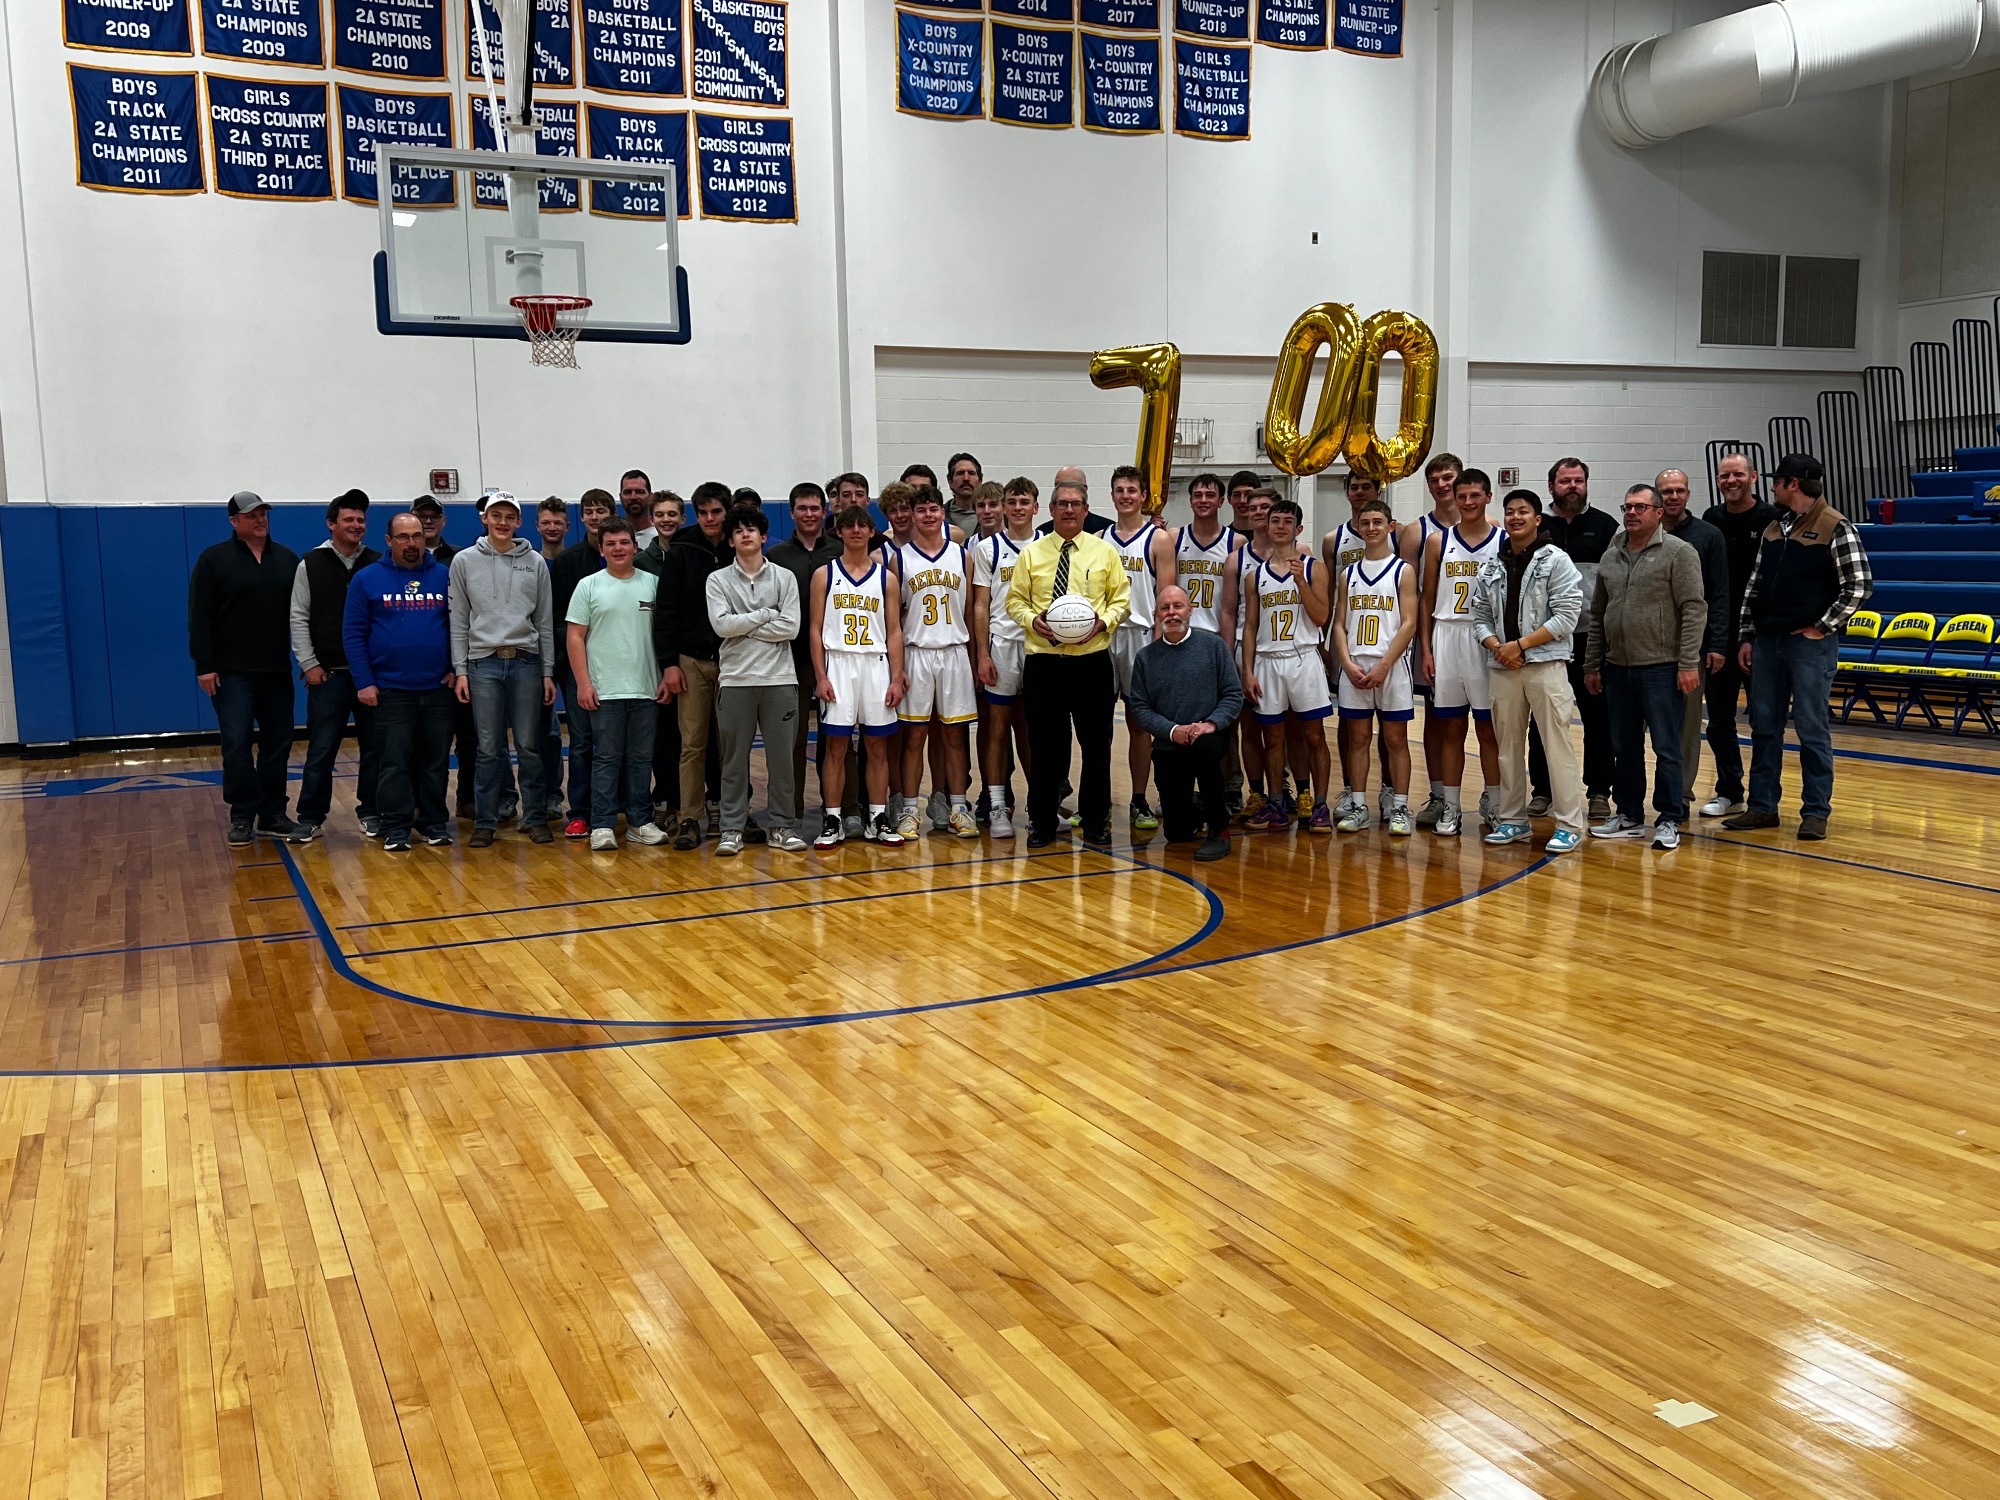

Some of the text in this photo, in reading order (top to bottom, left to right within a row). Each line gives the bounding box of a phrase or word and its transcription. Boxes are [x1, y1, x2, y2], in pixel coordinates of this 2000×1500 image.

[252, 0, 299, 15] STATE
[537, 0, 568, 12] BOYS
[613, 0, 649, 11] BOYS
[713, 1, 784, 20] BASKETBALL
[1183, 0, 1244, 17] RUNNER-UP
[1349, 3, 1389, 18] 1A STATE
[356, 9, 421, 29] 2A STATE
[551, 15, 569, 28] 2A
[588, 9, 676, 30] BASKETBALL
[1108, 10, 1134, 22] 2017
[1266, 9, 1319, 25] CHAMPIONS
[106, 20, 150, 38] 2009
[217, 14, 307, 37] CHAMPIONS
[754, 20, 784, 36] BOYS
[926, 24, 956, 39] BOYS
[1200, 19, 1226, 33] 2018
[1341, 16, 1397, 34] RUNNER-UP
[348, 27, 431, 49] CHAMPIONS
[601, 30, 665, 49] 2A STATE
[1018, 34, 1047, 48] BOYS
[1280, 28, 1305, 41] 2019
[243, 39, 285, 56] 2009
[694, 0, 785, 101] SPORTSMANSHIP
[769, 38, 784, 51] 2A
[908, 39, 972, 57] X-COUNTRY
[1107, 44, 1134, 57] BOYS
[1357, 36, 1381, 50] 2019
[372, 53, 408, 69] 2010
[594, 48, 675, 67] CHAMPIONS
[695, 48, 720, 64] 2011
[1003, 49, 1063, 66] X-COUNTRY
[1195, 51, 1230, 65] GIRLS
[695, 65, 743, 82] SCHOOL
[913, 58, 968, 75] 2A STATE
[1178, 64, 1248, 82] BASKETBALL
[620, 69, 650, 84] 2011
[910, 74, 973, 92] CHAMPIONS
[1007, 68, 1059, 84] 2A STATE
[1097, 76, 1148, 91] 2A STATE
[112, 78, 157, 95] BOYS
[695, 81, 764, 100] COMMUNITY
[1003, 85, 1063, 101] RUNNER-UP
[1186, 83, 1238, 99] 2A STATE
[244, 89, 290, 106] GIRLS
[927, 95, 957, 109] 2020
[1094, 93, 1153, 108] CHAMPIONS
[107, 100, 166, 118] TRACK
[375, 99, 415, 114] BOYS
[1020, 105, 1046, 118] 2021
[1184, 98, 1245, 115] CHAMPIONS
[212, 105, 325, 128] CROSS COUNTRY
[1108, 112, 1139, 124] 2022
[1199, 118, 1228, 131] 2023
[95, 121, 182, 140] 2A STATE
[347, 115, 446, 136] BASKETBALL
[542, 126, 575, 141] BOYS
[621, 118, 656, 133] BOYS
[724, 120, 763, 135] GIRLS
[230, 129, 310, 148] 2A STATE
[616, 136, 662, 152] TRACK
[698, 137, 791, 156] CROSS COUNTRY
[93, 143, 187, 163] CHAMPIONS
[221, 148, 322, 169] THIRD PLACE
[558, 146, 575, 157] 2A
[347, 156, 449, 179] THIR PLACE
[713, 159, 780, 175] 2A STATE
[123, 168, 160, 183] 2011
[257, 174, 292, 189] 2011
[392, 183, 420, 198] 012
[709, 177, 786, 194] CHAMPIONS
[623, 196, 660, 211] 2012
[733, 198, 766, 212] 2012
[909, 569, 961, 594] BEREAN
[383, 593, 444, 607] KANSAS
[1188, 579, 1214, 608] 20
[1261, 590, 1301, 609] BEREA
[833, 594, 879, 612] BEREAN
[923, 594, 952, 625] 31
[1349, 595, 1395, 611] BEREAN
[844, 614, 873, 645] 32
[1271, 610, 1293, 641] 12
[1357, 615, 1379, 645] 10
[1849, 617, 1876, 630] EREAN
[1892, 618, 1930, 631] BEREAN
[1947, 620, 1988, 634] BEREAN
